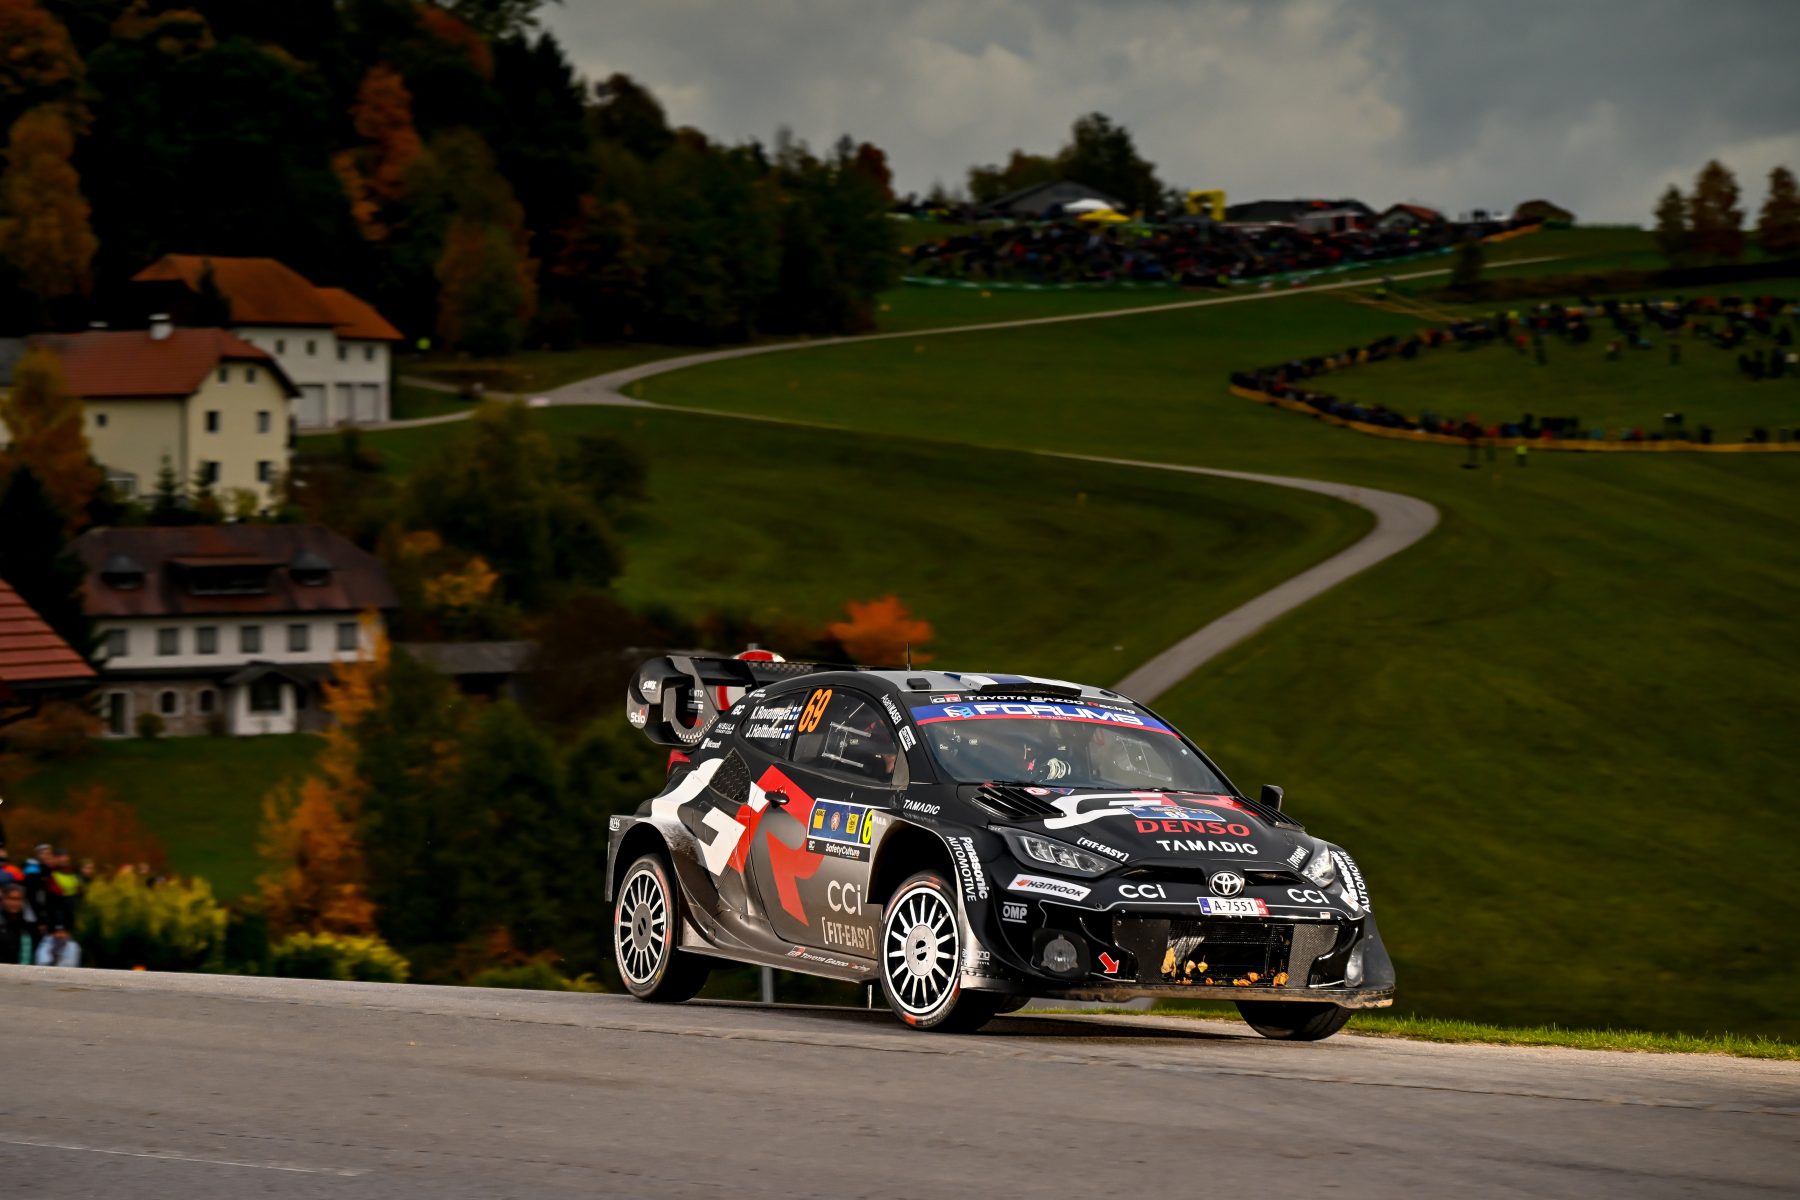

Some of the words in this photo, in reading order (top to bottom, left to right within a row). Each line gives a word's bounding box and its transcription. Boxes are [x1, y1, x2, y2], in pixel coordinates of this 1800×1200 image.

[798, 688, 833, 733] 69
[973, 704, 1144, 726] FORUM8
[902, 799, 941, 815] TAMADIC
[1134, 819, 1251, 837] DENSO
[825, 843, 860, 856] SafetyCulture
[1155, 839, 1259, 855] TAMADIC
[946, 836, 977, 902] AUTOMOTIVE
[958, 836, 990, 900] Panasonic
[1002, 904, 1028, 920] OMP
[1213, 900, 1255, 912] A-7551
